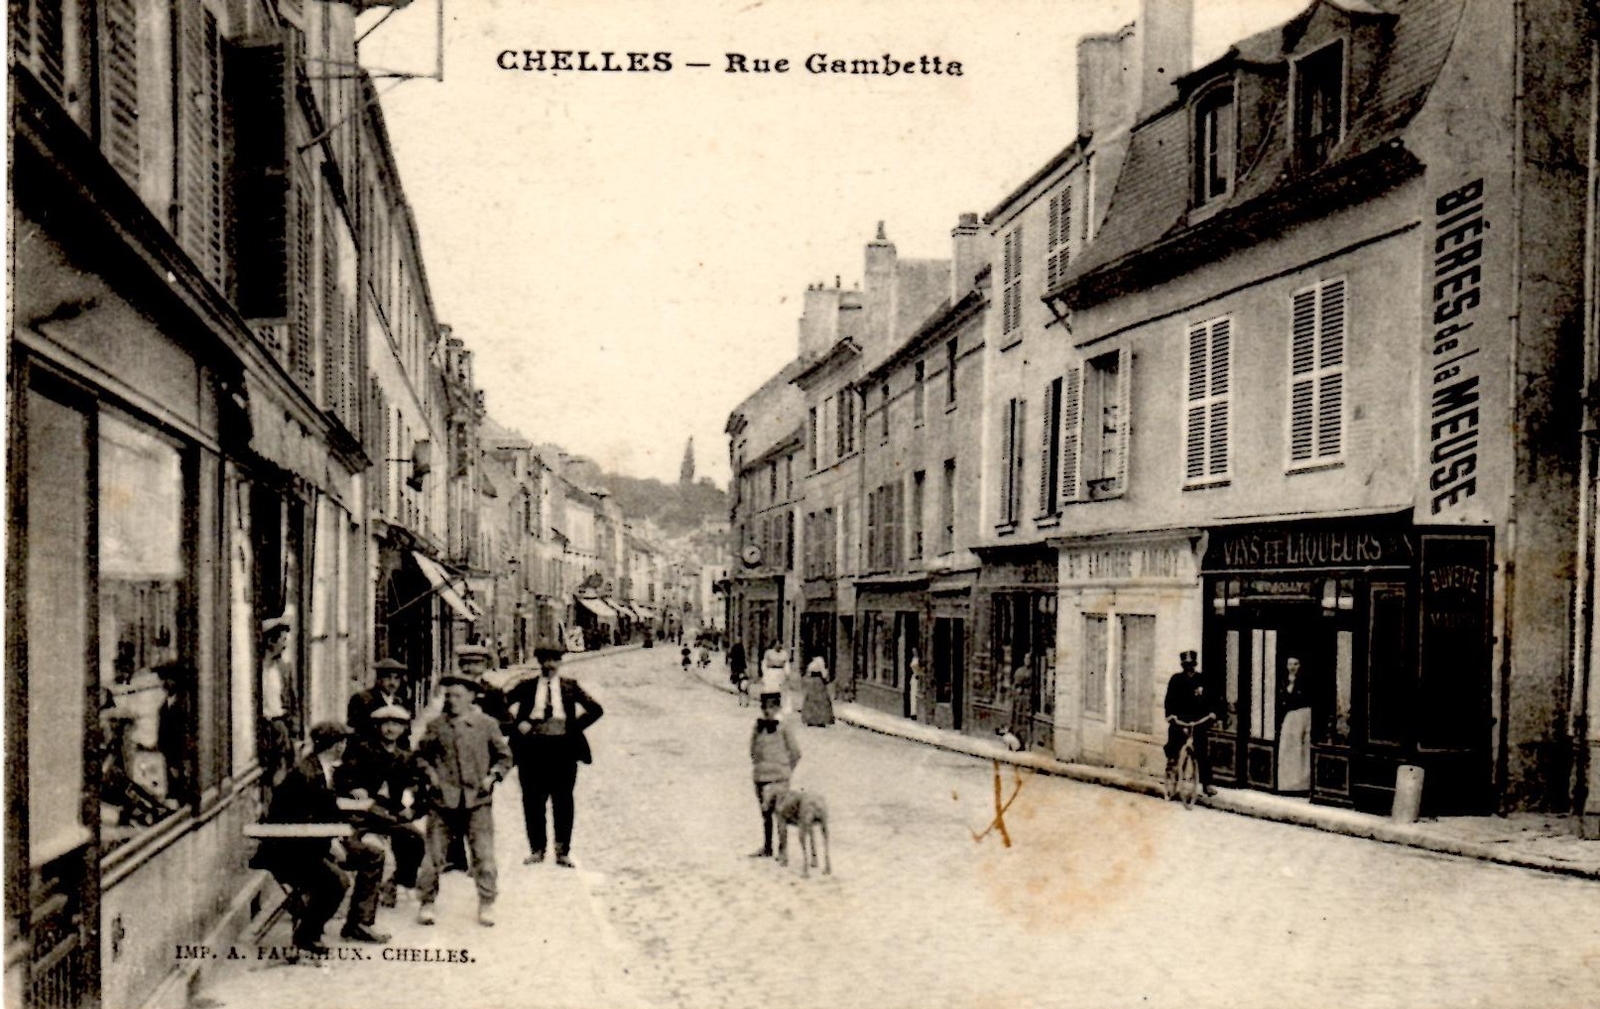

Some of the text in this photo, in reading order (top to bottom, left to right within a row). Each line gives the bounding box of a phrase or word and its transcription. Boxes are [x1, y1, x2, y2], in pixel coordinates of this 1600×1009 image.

[1433, 322, 1474, 355] de
[1433, 347, 1480, 384] la
[1430, 375, 1481, 516] MEUSE
[1264, 540, 1283, 565] ET
[1285, 531, 1382, 566] LIQUEURS
[1428, 564, 1482, 594] BUVETTE
